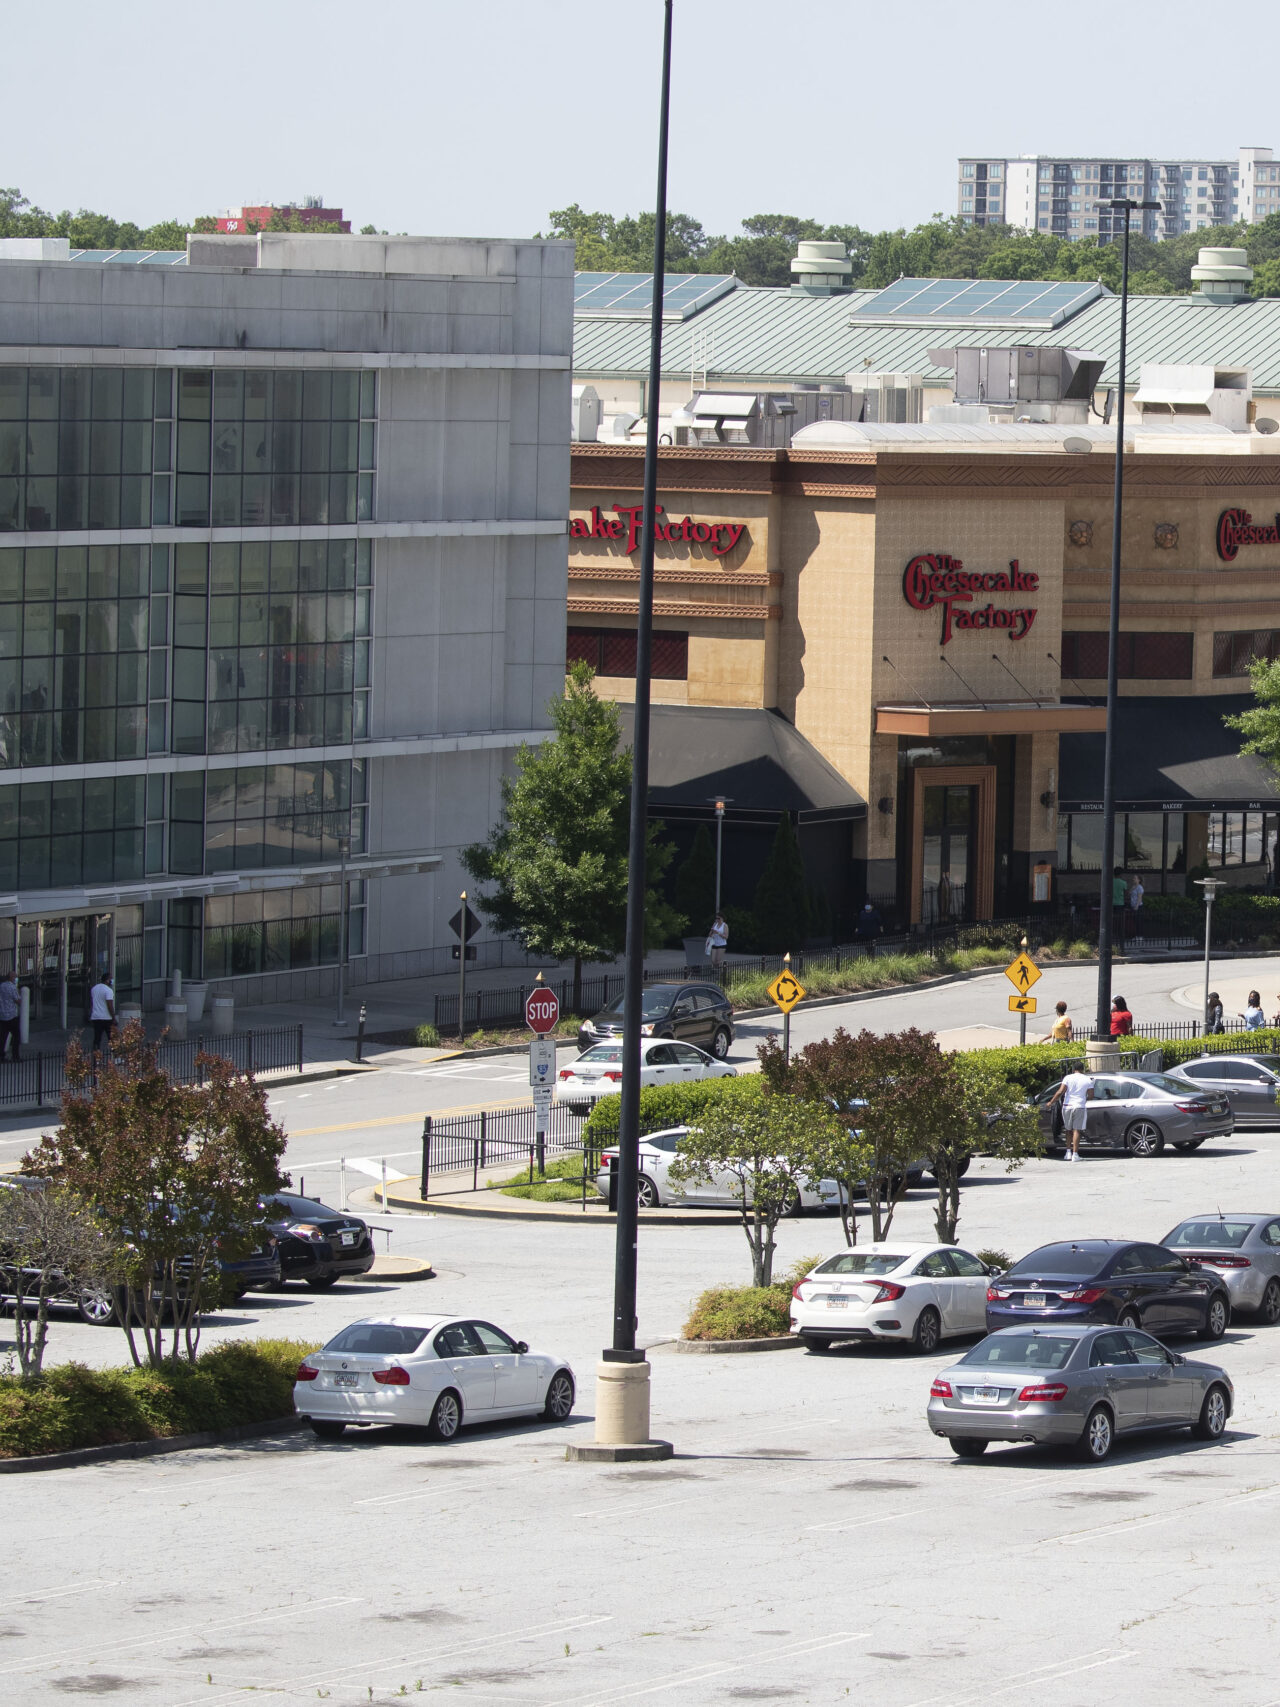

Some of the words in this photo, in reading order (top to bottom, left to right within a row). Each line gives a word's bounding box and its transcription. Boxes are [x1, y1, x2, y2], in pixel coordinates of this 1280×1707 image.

[936, 554, 963, 571] The
[903, 553, 1040, 610] Cheesecake
[931, 592, 1038, 646] Factory
[528, 1001, 557, 1020] STOP
